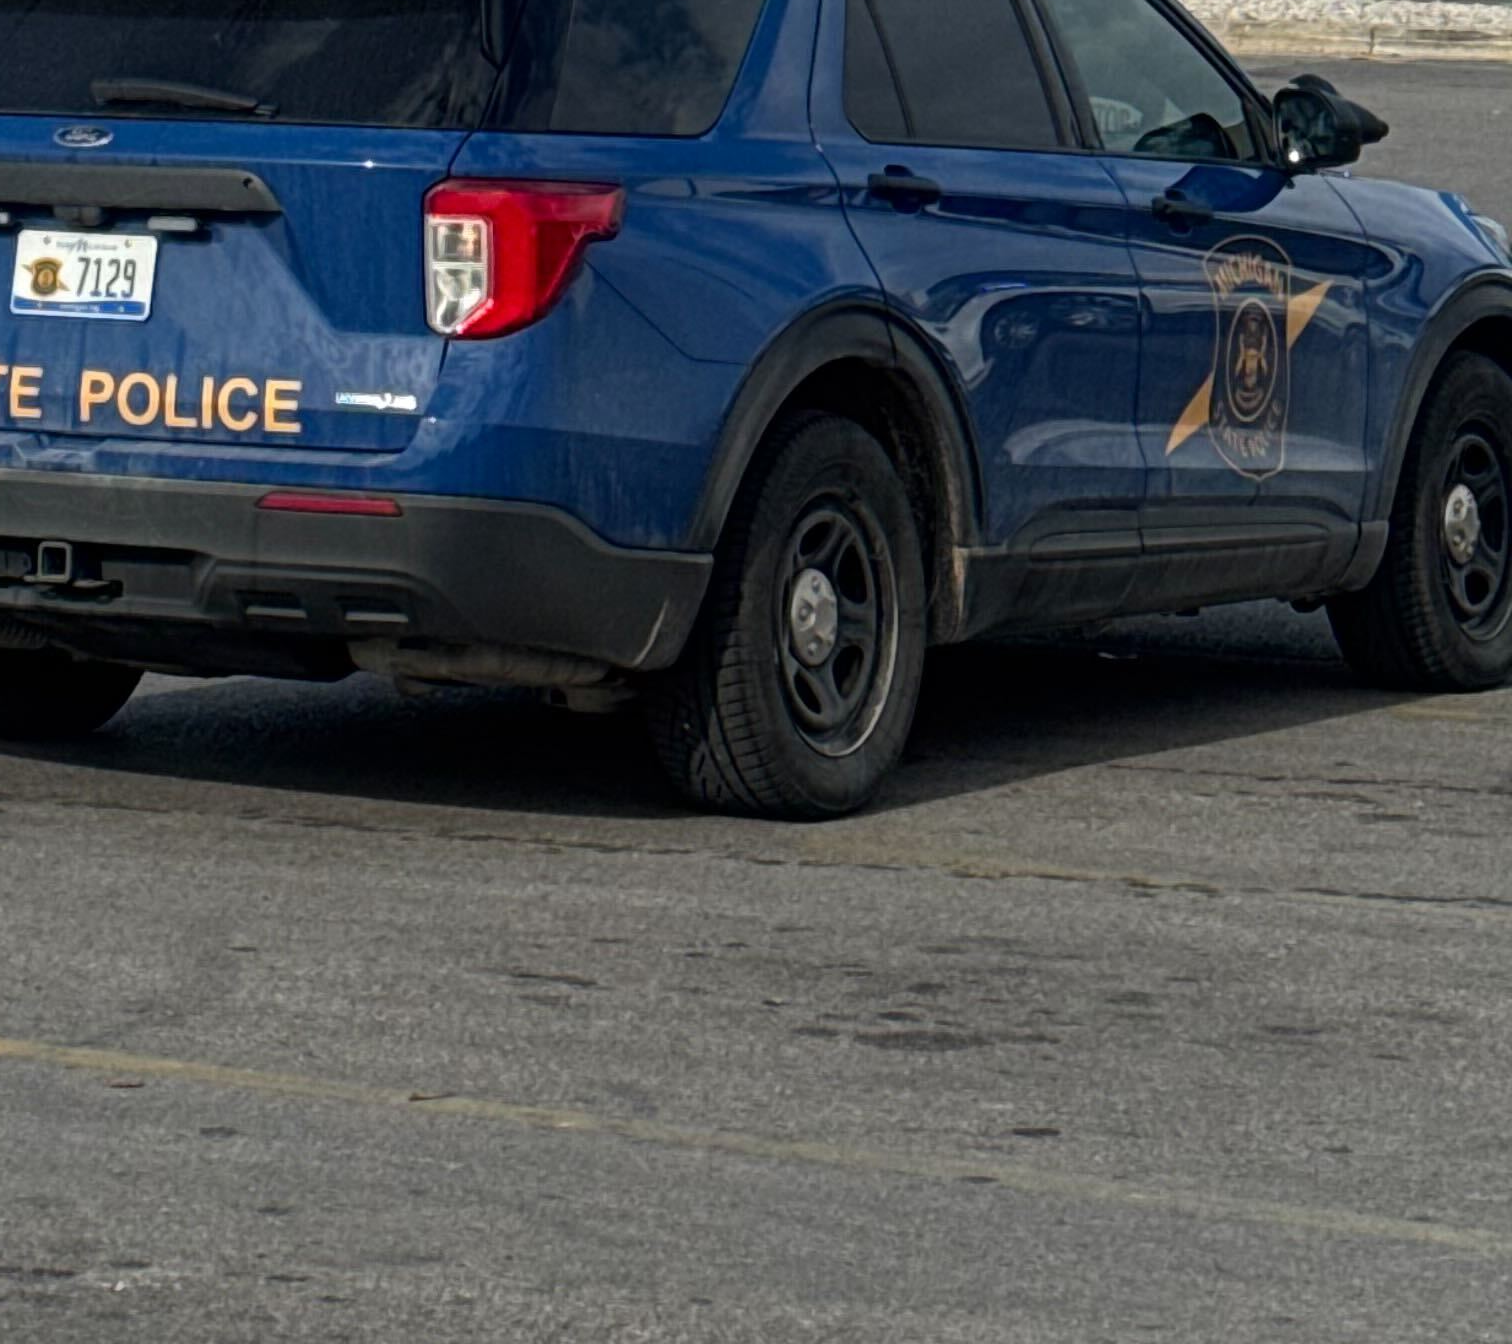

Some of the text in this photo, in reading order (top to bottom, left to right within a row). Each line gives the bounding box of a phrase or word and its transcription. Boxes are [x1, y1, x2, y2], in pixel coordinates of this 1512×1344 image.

[76, 255, 137, 299] 7129
[1215, 254, 1284, 302] MICHIGAN
[79, 369, 303, 434] POLICE
